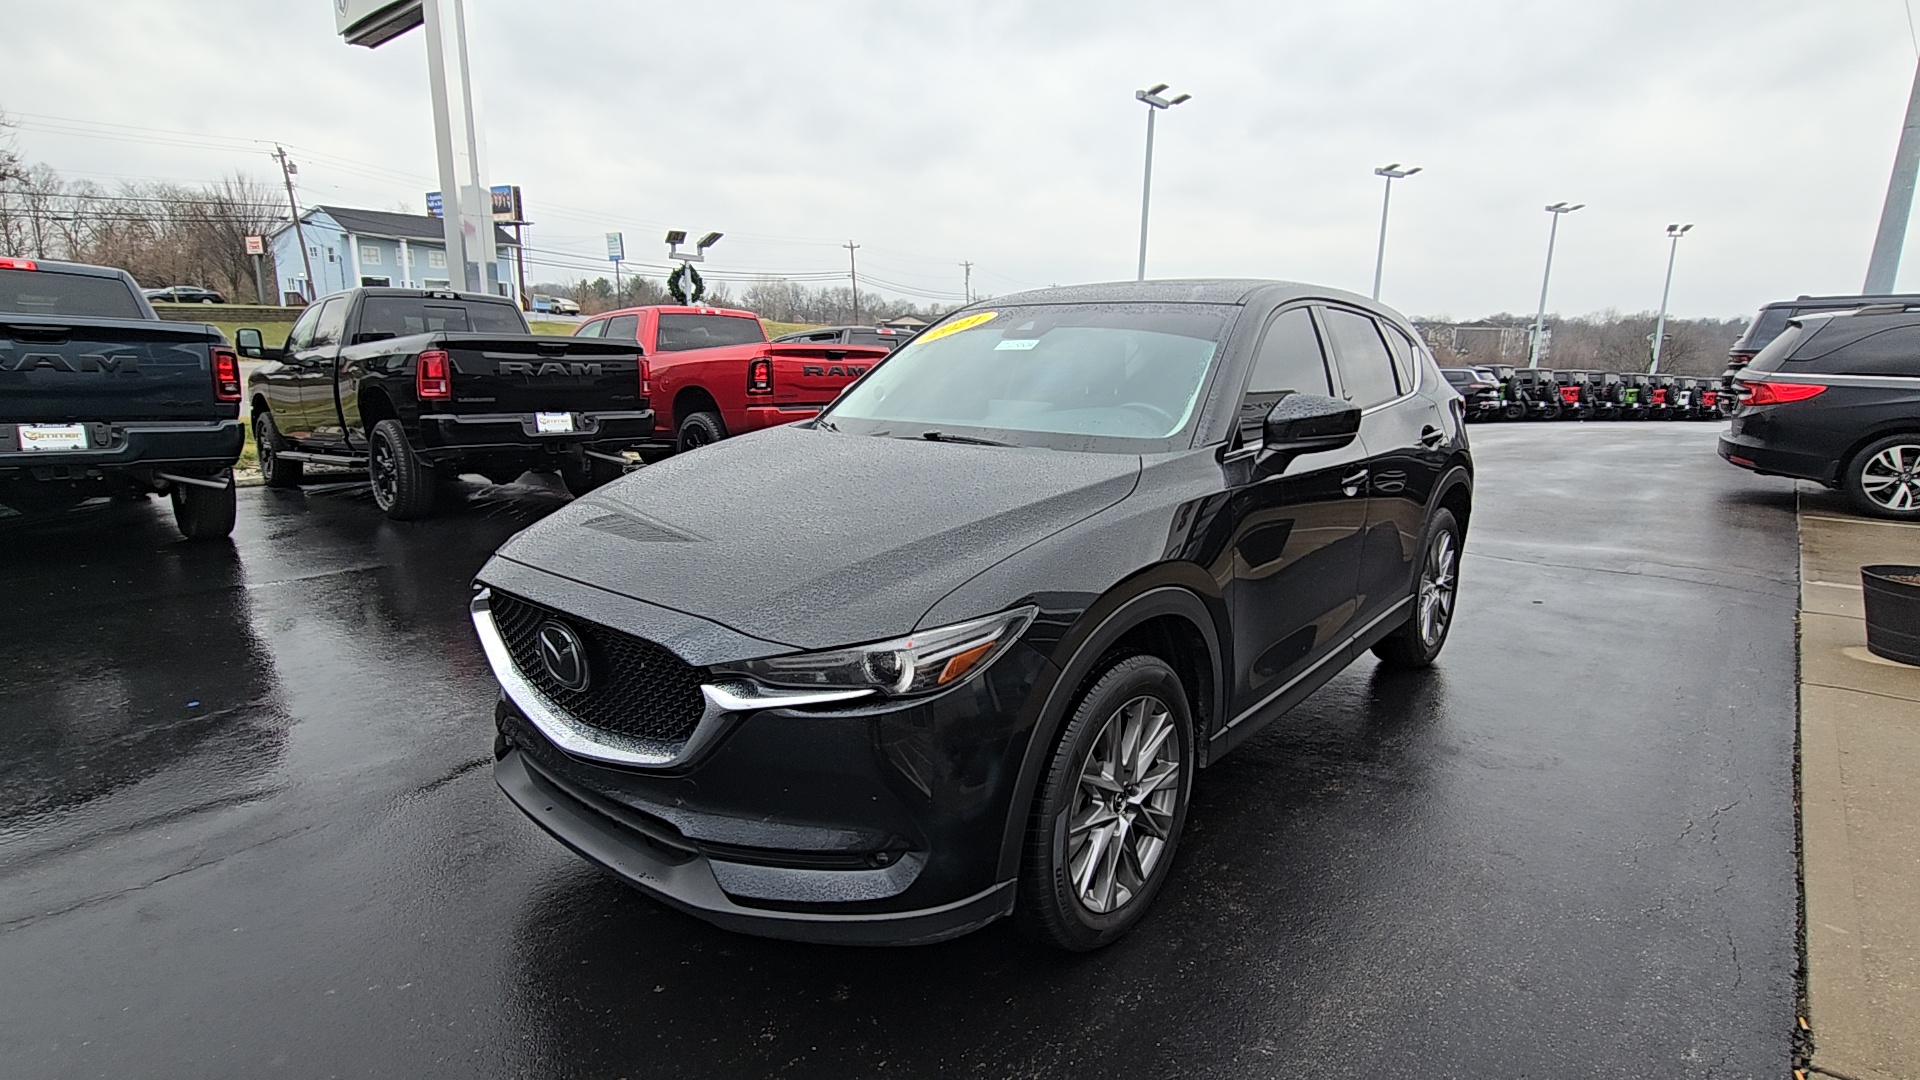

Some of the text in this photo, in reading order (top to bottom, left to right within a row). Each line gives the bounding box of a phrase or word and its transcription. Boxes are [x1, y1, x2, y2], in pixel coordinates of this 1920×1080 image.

[0, 353, 138, 372] AM
[499, 361, 602, 376] RAM
[803, 365, 867, 377] RAM
